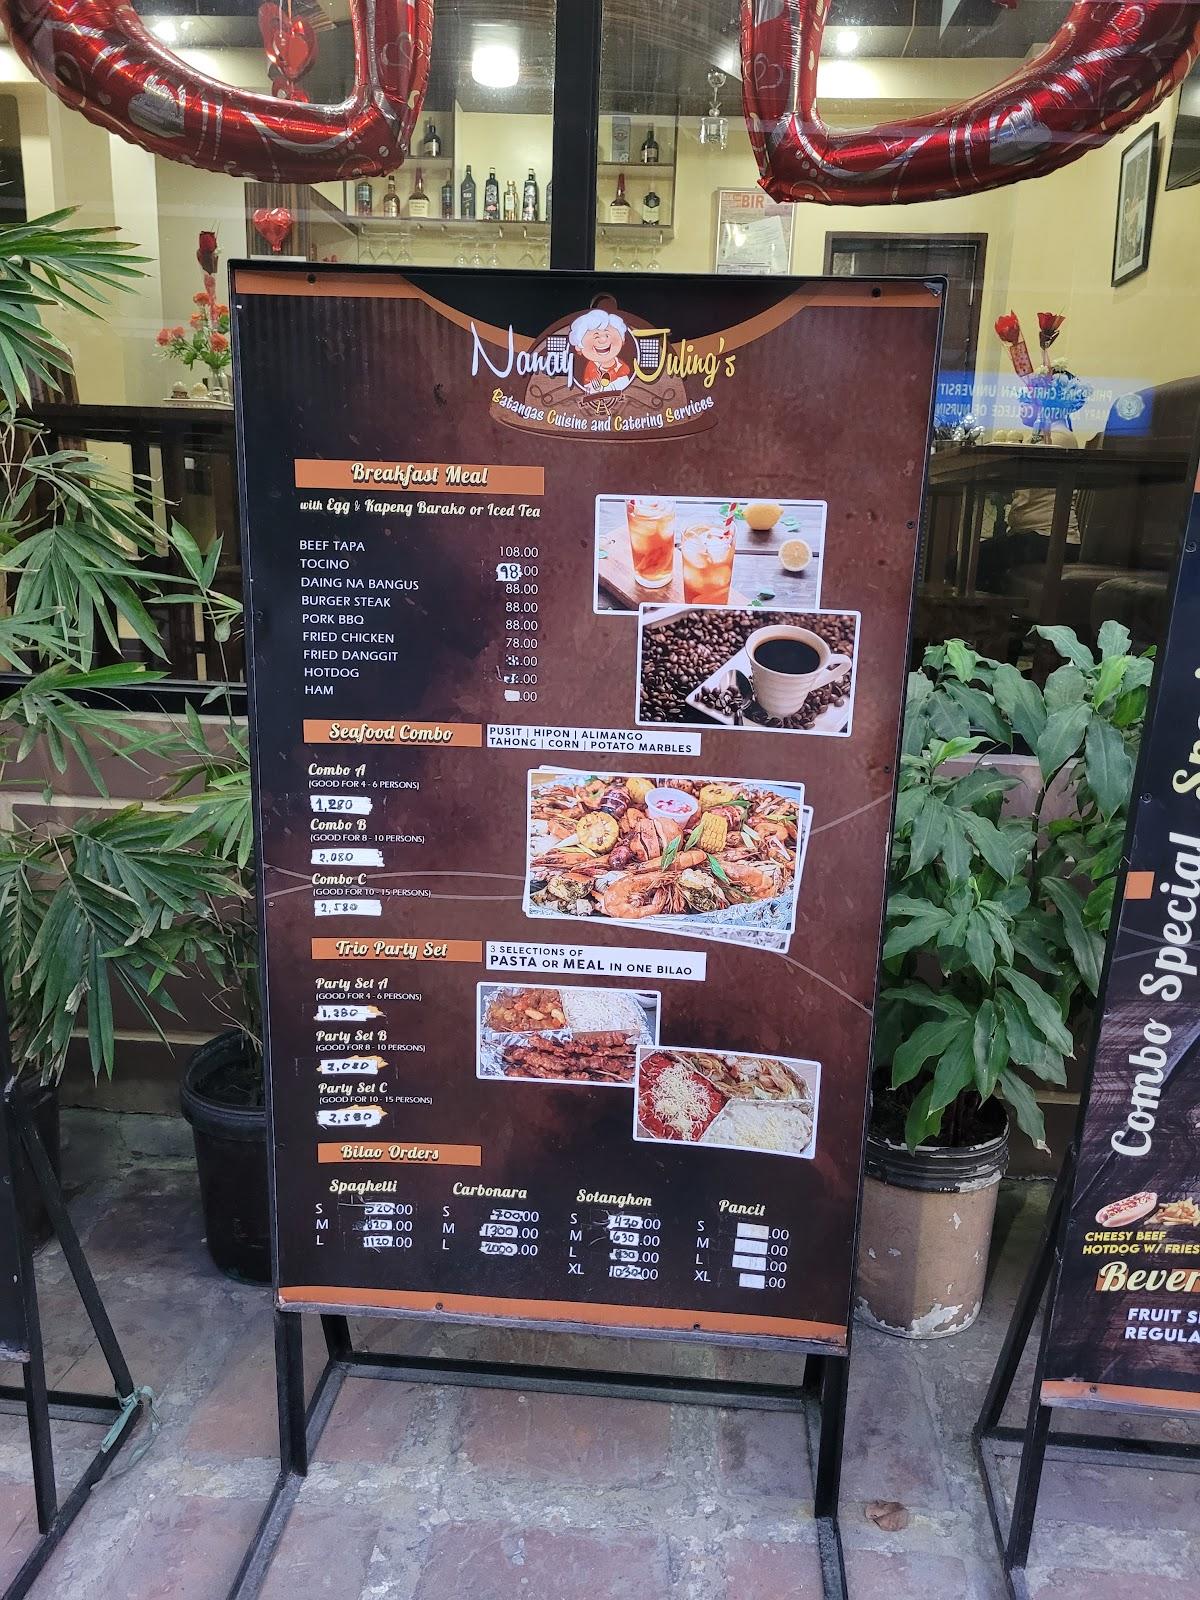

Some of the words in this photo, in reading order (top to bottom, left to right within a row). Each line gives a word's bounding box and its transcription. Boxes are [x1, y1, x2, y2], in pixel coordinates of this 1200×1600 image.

[741, 194, 765, 209] BIR
[471, 321, 573, 387] Nanay
[633, 328, 736, 388] Juling's
[492, 388, 544, 422] Batangas
[547, 410, 588, 430] Cuisine
[591, 415, 611, 431] and
[614, 413, 663, 431] Catering
[665, 396, 714, 423] Services
[351, 463, 439, 488] Breakfast
[445, 466, 488, 486] Meal
[300, 500, 323, 511] with
[326, 498, 350, 515] Egg
[364, 499, 413, 517] Kapeng
[417, 501, 466, 515] Barako
[470, 506, 484, 516] or
[487, 503, 515, 517] Iced
[518, 504, 541, 518] Tea
[299, 540, 329, 551] BEEF
[333, 541, 365, 551] TAPA
[500, 546, 539, 558] 108.00
[300, 558, 350, 569] TOCINO
[301, 577, 342, 588] DAING
[346, 578, 364, 589] NA
[368, 579, 419, 591] BANGUS
[505, 583, 539, 595] 88.00
[301, 595, 350, 606] BURGER
[354, 596, 391, 607] STEAK
[505, 602, 538, 613] 88.00
[302, 614, 334, 624] PORK
[338, 614, 364, 625] BBQ
[505, 620, 538, 631] 88.00
[303, 632, 337, 642] FRIED
[341, 632, 394, 643] CHICKEN
[505, 638, 538, 649] 78.00
[303, 650, 338, 660] FRIED
[342, 651, 399, 662] DANGGIT
[304, 667, 359, 678] HOTDOG
[304, 685, 334, 695] HAM
[329, 722, 395, 743] Seafood
[399, 724, 453, 743] Combo
[490, 727, 522, 736] PUSIT
[534, 729, 570, 738] HIPON
[581, 730, 643, 741] ALIMANGO
[490, 737, 537, 747] TAHONG
[548, 739, 579, 749] CORN
[590, 741, 634, 751] POTATO
[639, 743, 692, 753] MARBLES
[308, 763, 351, 776] Combo
[355, 764, 366, 777] A
[308, 780, 340, 788] (GOOD
[341, 780, 359, 788] FOR
[380, 781, 420, 791] PERSONS)
[310, 819, 352, 831] Combo
[356, 819, 367, 831] B
[310, 834, 341, 842] (GOOD
[343, 834, 360, 842] FOR
[362, 834, 367, 842] 8
[386, 835, 425, 844] PERSONS)
[312, 873, 353, 885] Combo
[356, 873, 367, 885] C
[313, 888, 343, 897] (GOOD
[345, 888, 362, 896] FOR
[392, 889, 431, 898] PERSONS)
[1138, 831, 1200, 1003] Special
[335, 940, 369, 957] Trio
[374, 941, 418, 960] Party
[423, 942, 448, 959] Set
[490, 945, 496, 953] 3
[499, 946, 565, 956] SELECTIONS
[569, 949, 583, 957] OF
[490, 956, 537, 968] PASTA
[542, 959, 559, 968] OR
[563, 959, 605, 971] MEAL
[610, 963, 622, 971] IN
[627, 964, 652, 973] ONE
[657, 965, 692, 975] BILAO
[315, 977, 351, 991] Party
[354, 978, 374, 989] Set
[378, 977, 389, 990] A
[316, 993, 345, 1001] (GOOD
[384, 993, 422, 1001] PERSONS)
[315, 1030, 351, 1044] Party
[354, 1030, 373, 1041] Set
[377, 1030, 387, 1041] B
[316, 1044, 345, 1052] (GOOD
[388, 1044, 426, 1052] PERSONS)
[318, 1082, 352, 1095] Party
[357, 1082, 375, 1093] Set
[379, 1082, 388, 1093] C
[1110, 1017, 1173, 1157] Combo
[319, 1096, 348, 1104] (GOOD
[395, 1096, 433, 1105] PERSONS)
[340, 1144, 383, 1160] Bilao
[388, 1144, 439, 1161] Orders
[329, 1178, 398, 1195] Spaghetti
[452, 1181, 527, 1199] Carbonara
[315, 1203, 323, 1214] S
[443, 1206, 450, 1217] S
[718, 1199, 766, 1216] Pancit
[316, 1219, 329, 1230] M
[570, 1213, 577, 1225] S
[443, 1223, 455, 1234] M
[697, 1220, 705, 1232] S
[316, 1235, 324, 1246] L
[570, 1231, 582, 1241] M
[1085, 1231, 1133, 1242] CHEESY
[1136, 1231, 1166, 1241] BEEF
[442, 1239, 450, 1250] L
[696, 1237, 709, 1249] M
[569, 1247, 577, 1258] L
[1083, 1244, 1140, 1255] HOTDOG
[1143, 1244, 1161, 1254] W/
[1165, 1244, 1200, 1254] FRIES
[696, 1254, 703, 1265] L
[568, 1263, 584, 1275] XL
[694, 1270, 711, 1282] XL
[1128, 1308, 1181, 1322] FRUIT
